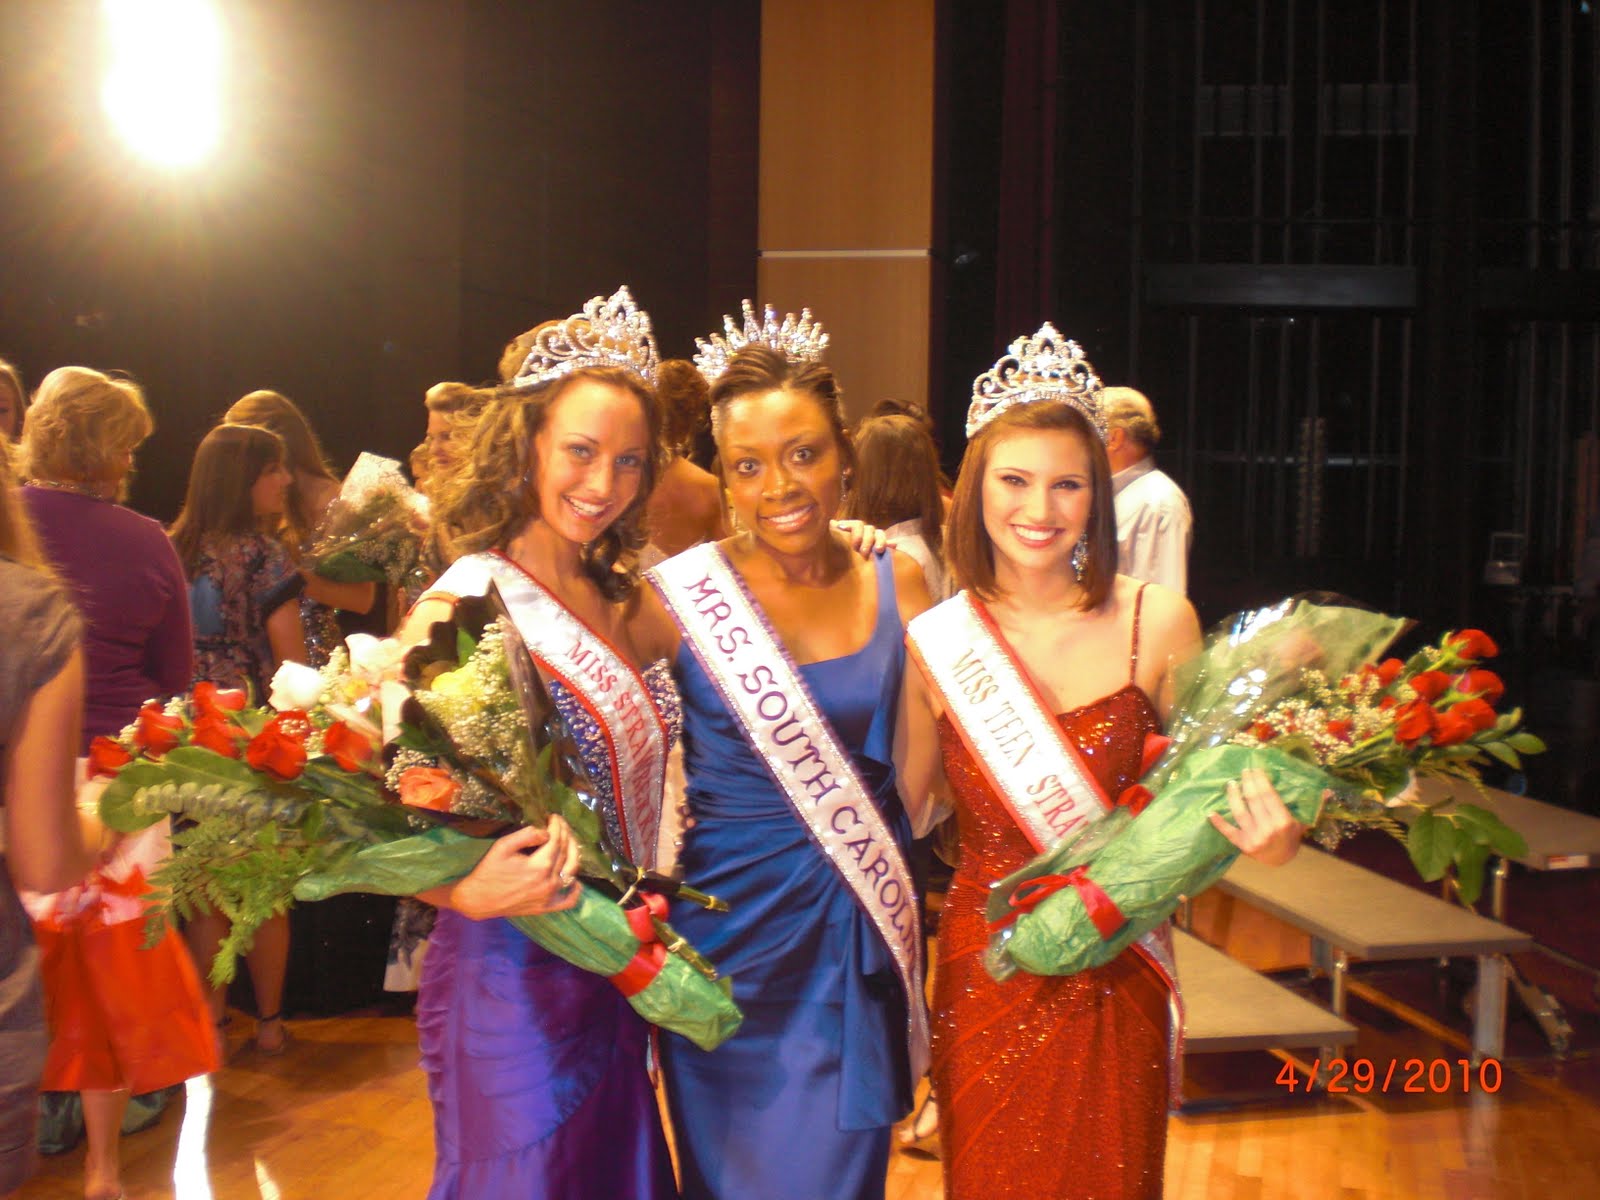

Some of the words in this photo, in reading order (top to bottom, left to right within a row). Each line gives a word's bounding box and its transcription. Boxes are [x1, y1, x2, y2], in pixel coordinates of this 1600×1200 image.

[564, 641, 618, 693] MISS
[951, 647, 1000, 705] MISS
[983, 700, 1036, 768] TEEN
[1026, 773, 1089, 837] STRA
[682, 572, 754, 663] MRS.
[736, 665, 842, 806] SOUTH
[830, 805, 913, 955] CAROL
